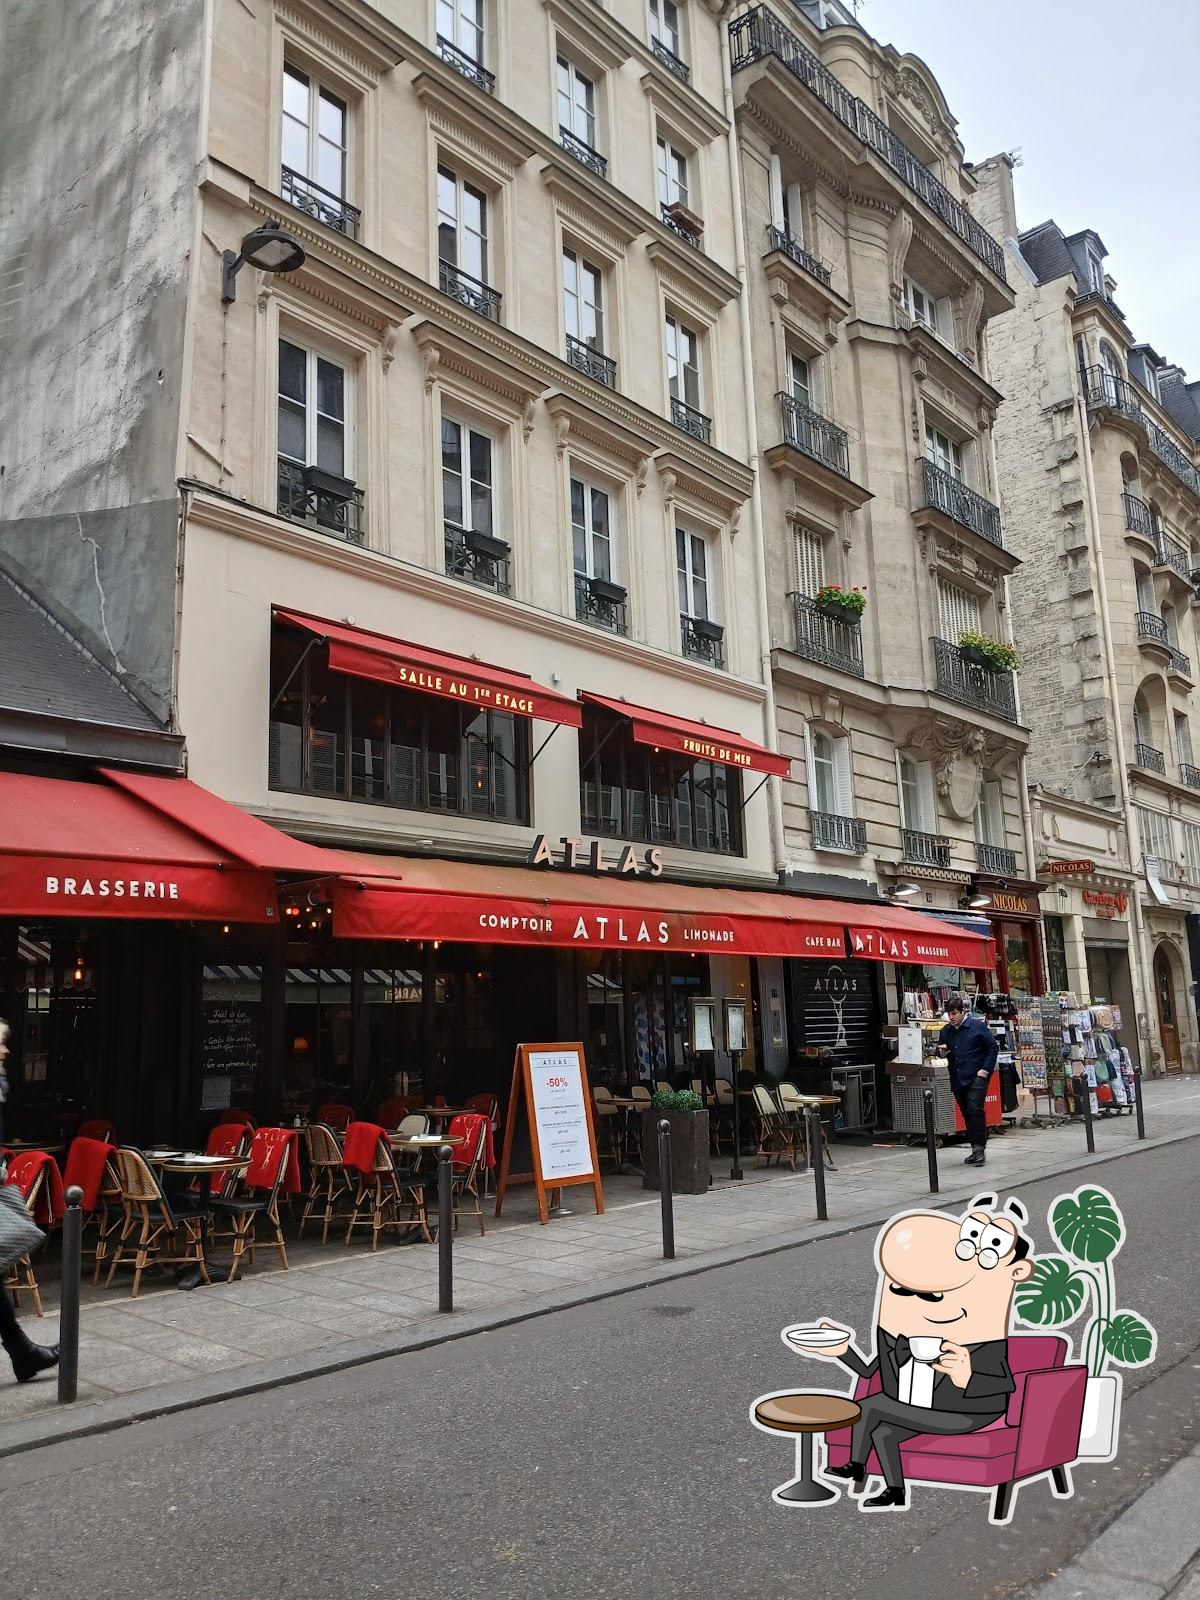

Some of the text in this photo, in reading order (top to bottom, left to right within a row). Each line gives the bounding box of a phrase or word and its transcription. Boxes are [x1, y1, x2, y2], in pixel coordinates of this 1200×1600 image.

[399, 667, 533, 713] SALLE AU 1ER ETAGE
[683, 739, 751, 766] FRUITS DE MER
[529, 835, 663, 876] ATLAS
[1052, 862, 1090, 872] NICOLAS
[46, 876, 179, 899] BRASSERIE
[993, 893, 1028, 912] NICOLAS
[479, 914, 735, 944] COMPTOIR ATLAS LIMONADE
[805, 936, 841, 948] CAFE BAR
[855, 934, 949, 957] ATLAS BRASSERIE
[814, 978, 857, 991] ATLAS
[546, 1077, 568, 1088] -50%
